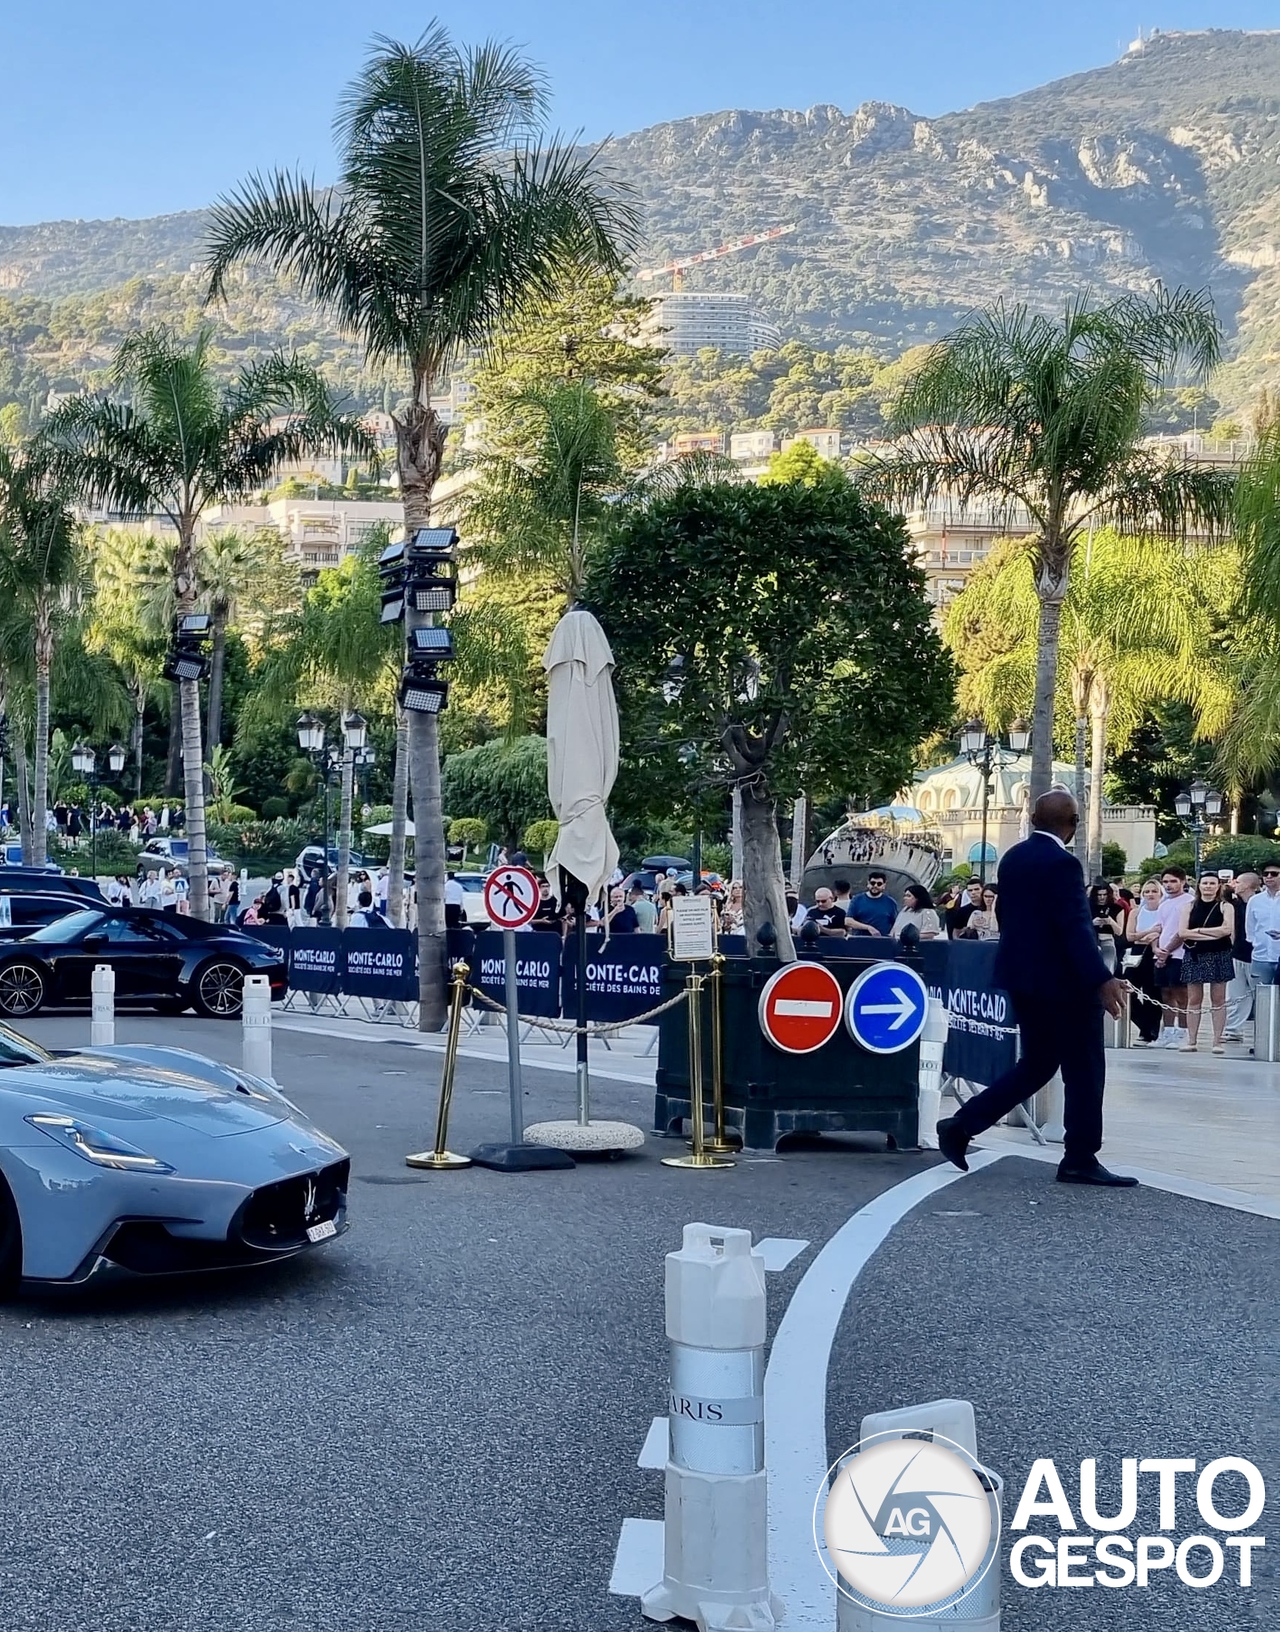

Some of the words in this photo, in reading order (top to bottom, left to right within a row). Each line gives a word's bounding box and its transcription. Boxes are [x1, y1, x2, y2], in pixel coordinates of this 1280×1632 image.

[607, 983, 621, 993] DES
[623, 985, 647, 994] BAINS
[649, 986, 660, 995] DE
[671, 1395, 723, 1421] ARIS
